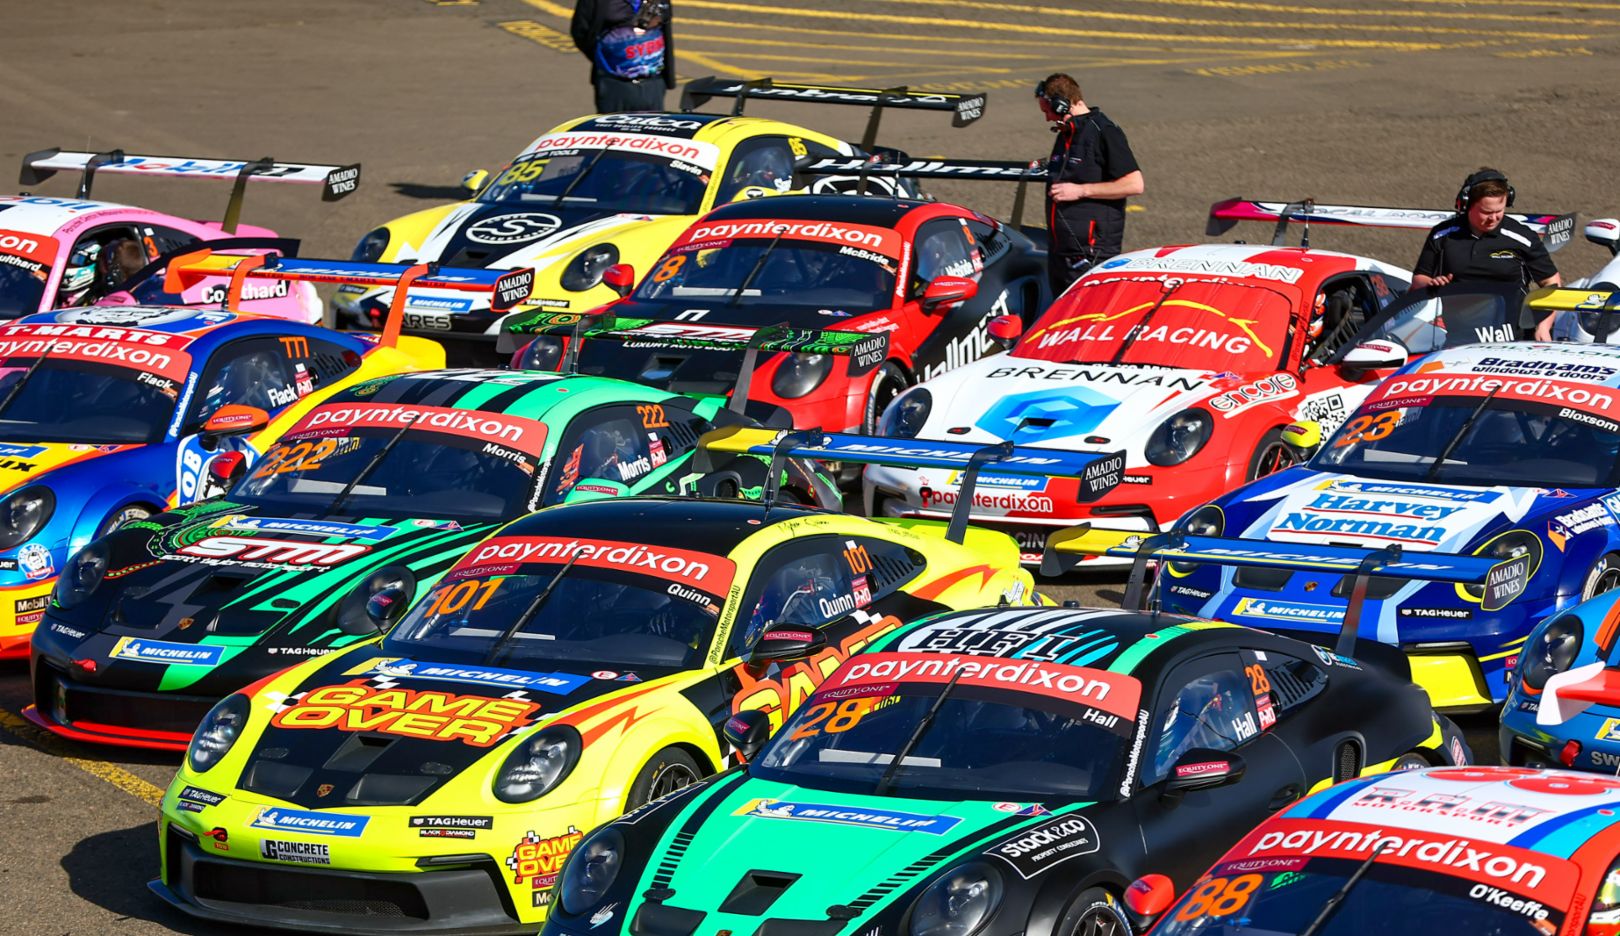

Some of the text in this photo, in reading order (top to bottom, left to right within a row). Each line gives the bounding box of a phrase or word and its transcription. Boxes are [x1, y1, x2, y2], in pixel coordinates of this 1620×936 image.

[957, 97, 984, 112] AMADIO
[960, 109, 981, 121] WINES
[535, 135, 700, 159] paynterdixon
[328, 168, 358, 185] AMADIO
[498, 159, 551, 186] 85
[332, 179, 356, 195] WINES
[689, 220, 883, 248] paynterdixon
[962, 225, 975, 245] 8
[1548, 217, 1574, 235] AMADIO
[1550, 230, 1570, 245] WINES
[839, 246, 890, 265] McBride
[652, 255, 687, 283] 8
[1127, 258, 1304, 285] BRENNAN
[498, 273, 532, 293] AMADIO
[502, 285, 529, 303] WINES
[1038, 325, 1251, 354] WALL RACING
[1475, 324, 1514, 343] Wall
[279, 336, 310, 359] 777
[854, 335, 886, 358] AMADIO
[857, 350, 884, 369] WINES
[1479, 358, 1619, 376] Bradnam's
[137, 372, 173, 391] Flack
[986, 367, 1203, 392] BRENNAN
[1472, 366, 1609, 382] windows & doors
[268, 388, 298, 409] Flack
[1209, 371, 1296, 412] encore
[1384, 376, 1614, 410] paynterdixon
[309, 403, 525, 442] paynterdixon
[637, 404, 669, 429] 222
[1559, 408, 1620, 432] Bloxsom
[1335, 411, 1403, 448] 23
[253, 438, 337, 480] 222
[483, 442, 527, 464] Morris
[835, 443, 1062, 465] MICHEIN
[617, 455, 651, 482] Morris
[1085, 457, 1123, 481] AMADIO
[1090, 473, 1119, 494] WINES
[1367, 485, 1485, 499] MICHELIN
[1306, 493, 1467, 521] Harvey
[262, 521, 378, 535] MICHELIN
[1275, 513, 1449, 542] Norman
[472, 541, 710, 581] paynterdixon
[843, 544, 874, 576] 101
[1490, 561, 1524, 586] AMADIO
[424, 577, 505, 619] 101
[667, 583, 711, 607] Quinn
[855, 587, 872, 607] PRO
[1494, 578, 1520, 601] WINES
[18, 599, 45, 612] Mobil
[819, 593, 854, 620] Quinn
[1268, 605, 1346, 620] MICHELIN
[140, 646, 212, 660] MICHELIN
[417, 667, 571, 687] MICHELIN
[843, 657, 1111, 702] paynterdixon
[1245, 664, 1272, 696] 28
[306, 686, 532, 722] GAME
[1259, 704, 1276, 728] PRO
[280, 705, 504, 745] OVER
[790, 697, 866, 742] 28
[1083, 708, 1119, 729] Hall
[1232, 711, 1256, 743] Hall
[280, 814, 357, 830] MICHELIN
[798, 806, 936, 830] MICHELIN
[1353, 800, 1517, 829] MOTORSPORT
[278, 841, 330, 856] CONCRETE
[279, 853, 331, 865] CONSTRUCTIONS
[1249, 828, 1547, 889] paynterdixon
[1174, 873, 1263, 922] 88
[1469, 883, 1550, 921] O'Keeffe
